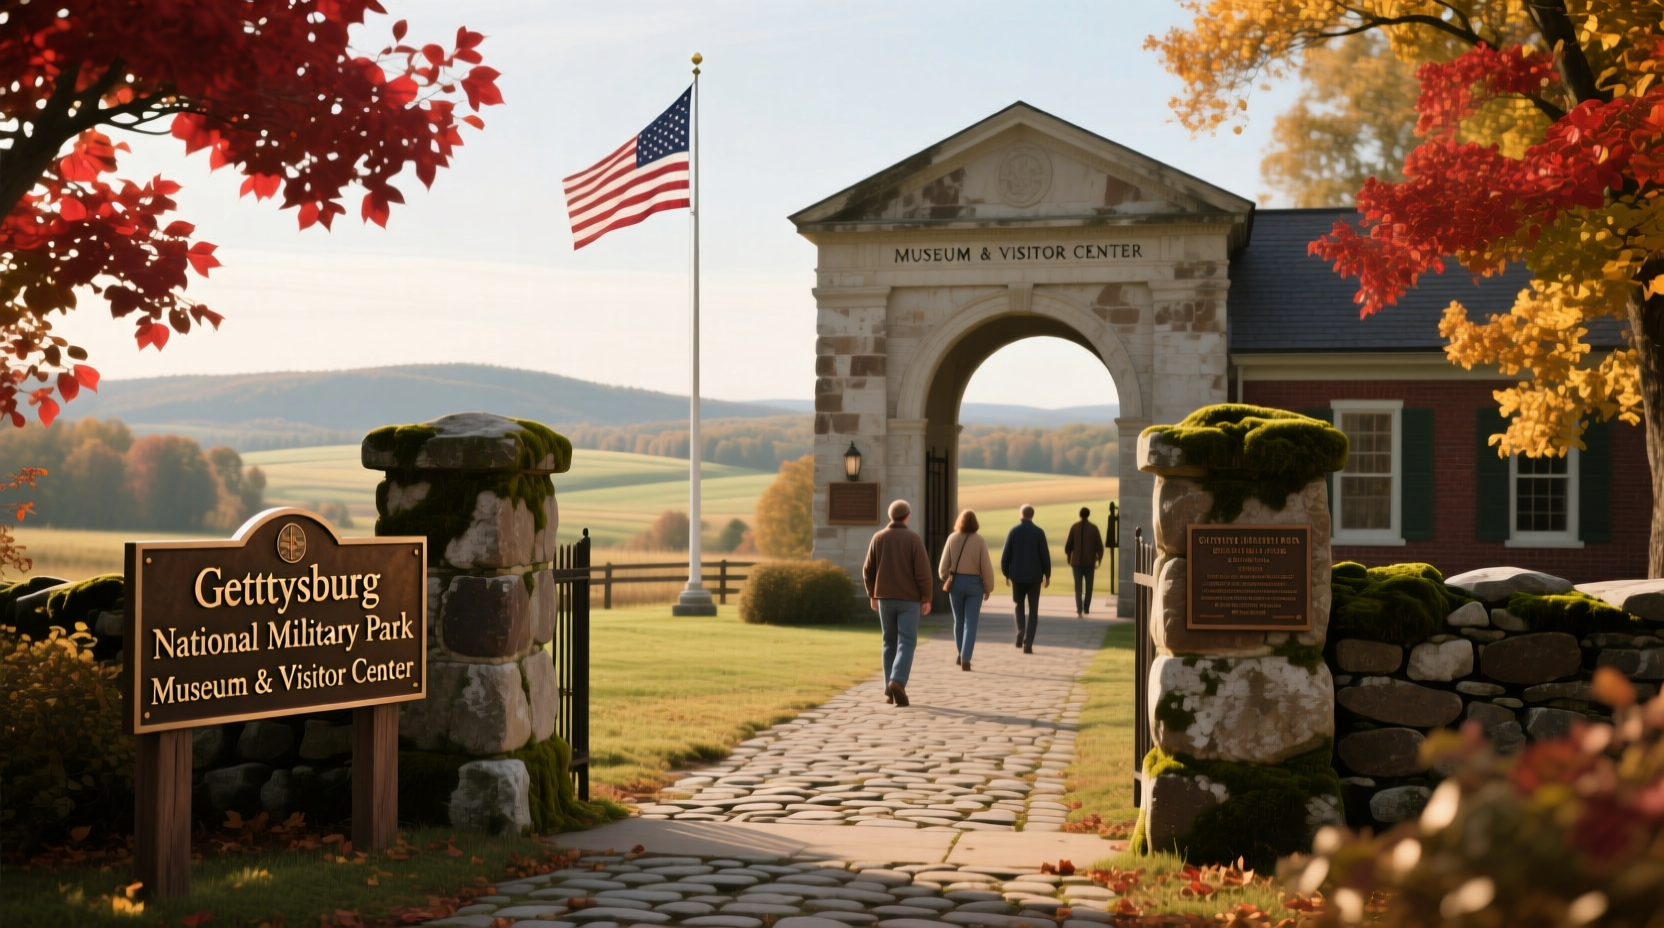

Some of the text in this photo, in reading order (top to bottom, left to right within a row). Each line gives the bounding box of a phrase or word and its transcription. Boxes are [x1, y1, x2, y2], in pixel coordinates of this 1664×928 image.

[894, 244, 1142, 263] MUSEUM & VISITOR CENTER
[194, 563, 381, 614] Getttysburg
[152, 611, 414, 659] National Military Park
[150, 658, 414, 705] Museum & Visitor Center
